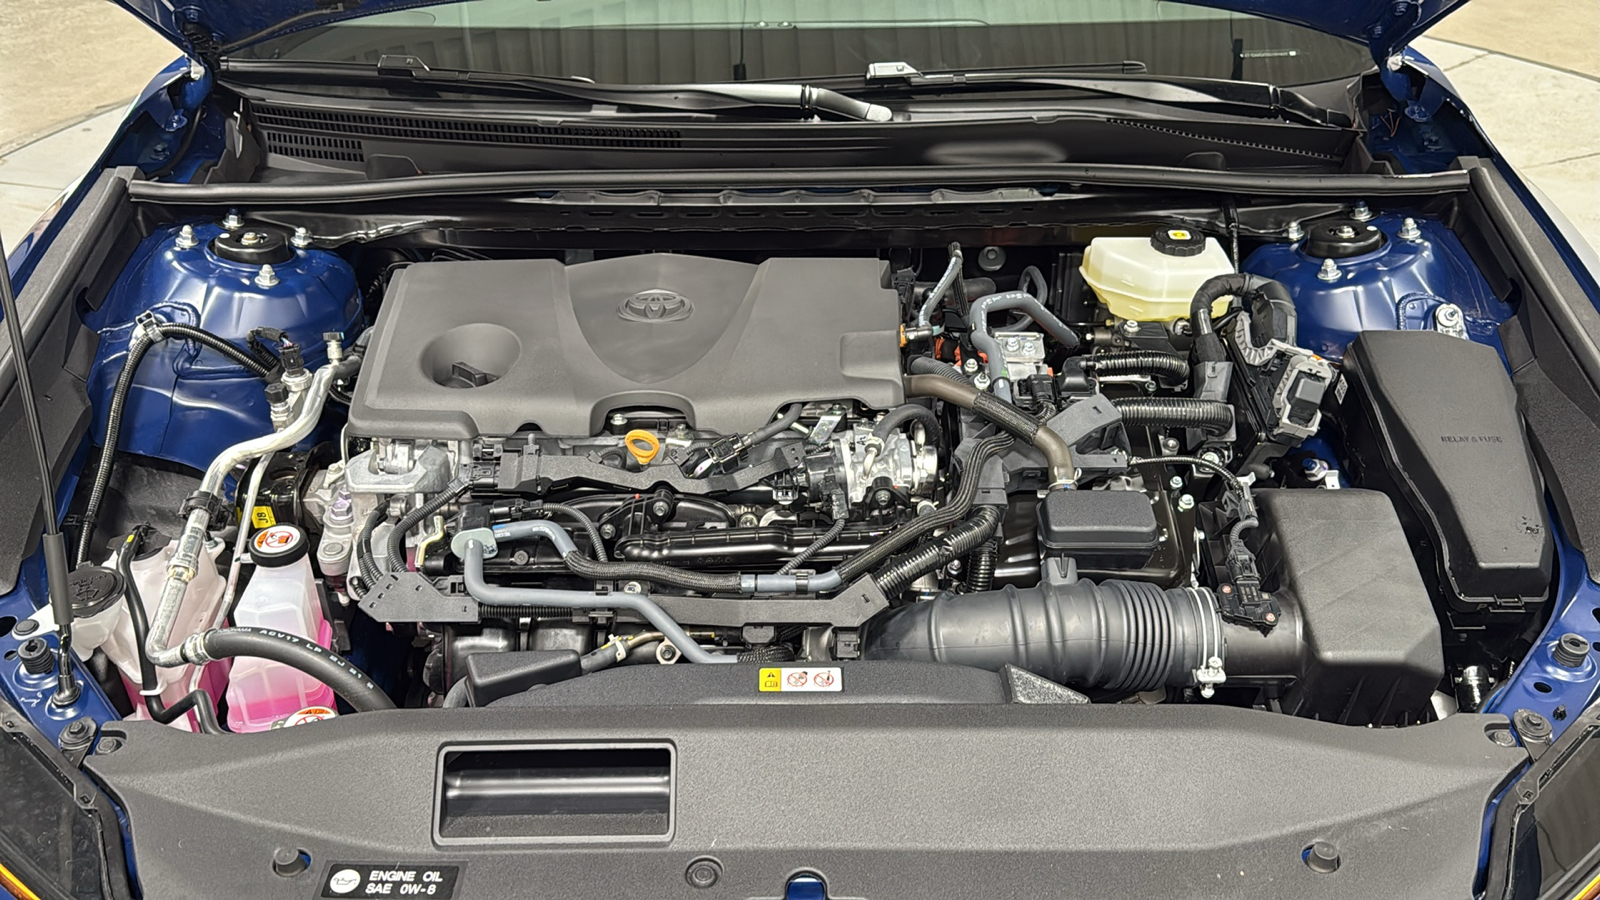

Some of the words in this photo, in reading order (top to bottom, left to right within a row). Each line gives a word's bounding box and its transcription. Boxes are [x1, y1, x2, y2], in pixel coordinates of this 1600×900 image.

[1440, 435, 1469, 443] RELAY
[1479, 435, 1503, 443] FUSE
[369, 870, 416, 881] ENGINE
[422, 871, 443, 883] OIL
[365, 883, 393, 894] SAE
[399, 884, 437, 895] 0W-8
